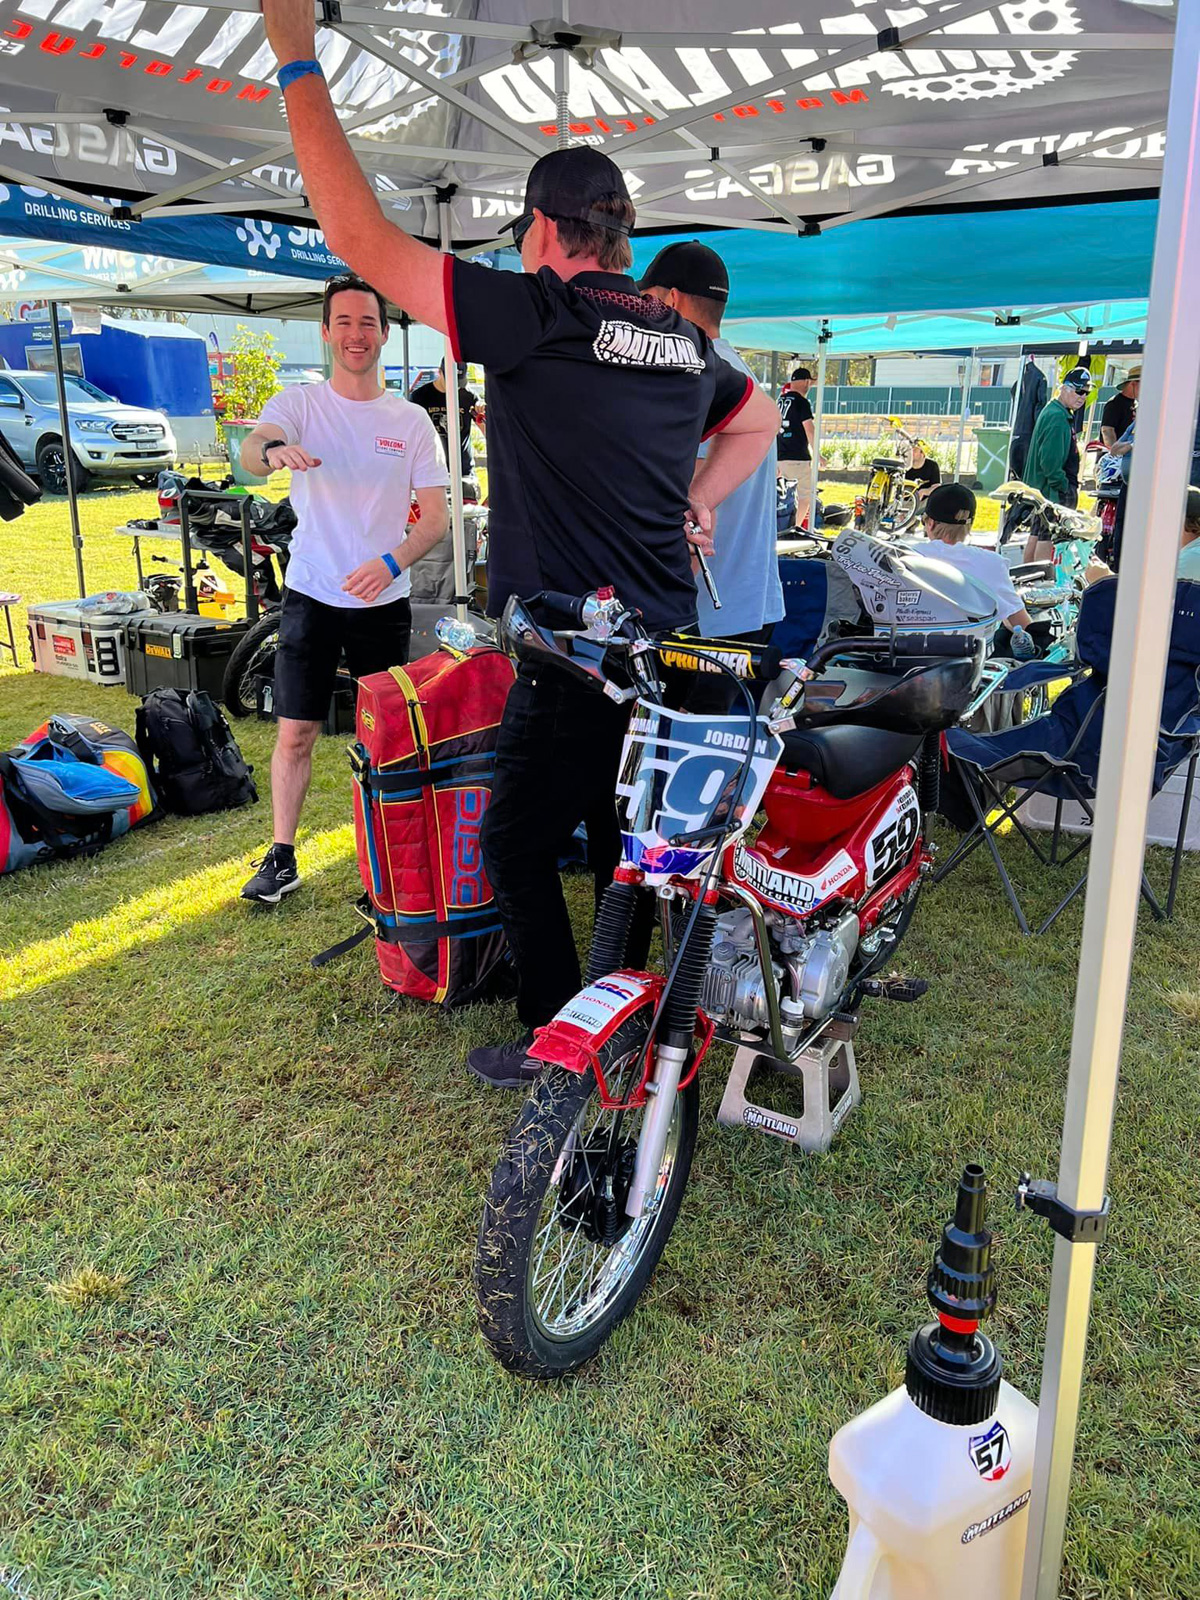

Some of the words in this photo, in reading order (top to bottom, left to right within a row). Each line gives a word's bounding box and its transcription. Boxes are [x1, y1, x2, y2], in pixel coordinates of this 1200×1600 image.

[24, 201, 77, 222] DRILLING
[291, 248, 327, 264] DRILLING
[606, 326, 702, 365] MAITLAND
[379, 439, 403, 449] VOLCOM
[703, 729, 767, 754] JORDAN
[452, 789, 486, 906] OGIO
[871, 807, 920, 882] 59
[828, 865, 854, 887] HONDA
[581, 994, 616, 1013] HONDA
[747, 1111, 798, 1137] MAITLAND
[975, 1432, 1005, 1476] 57
[966, 1491, 1031, 1540] MAITLAND
